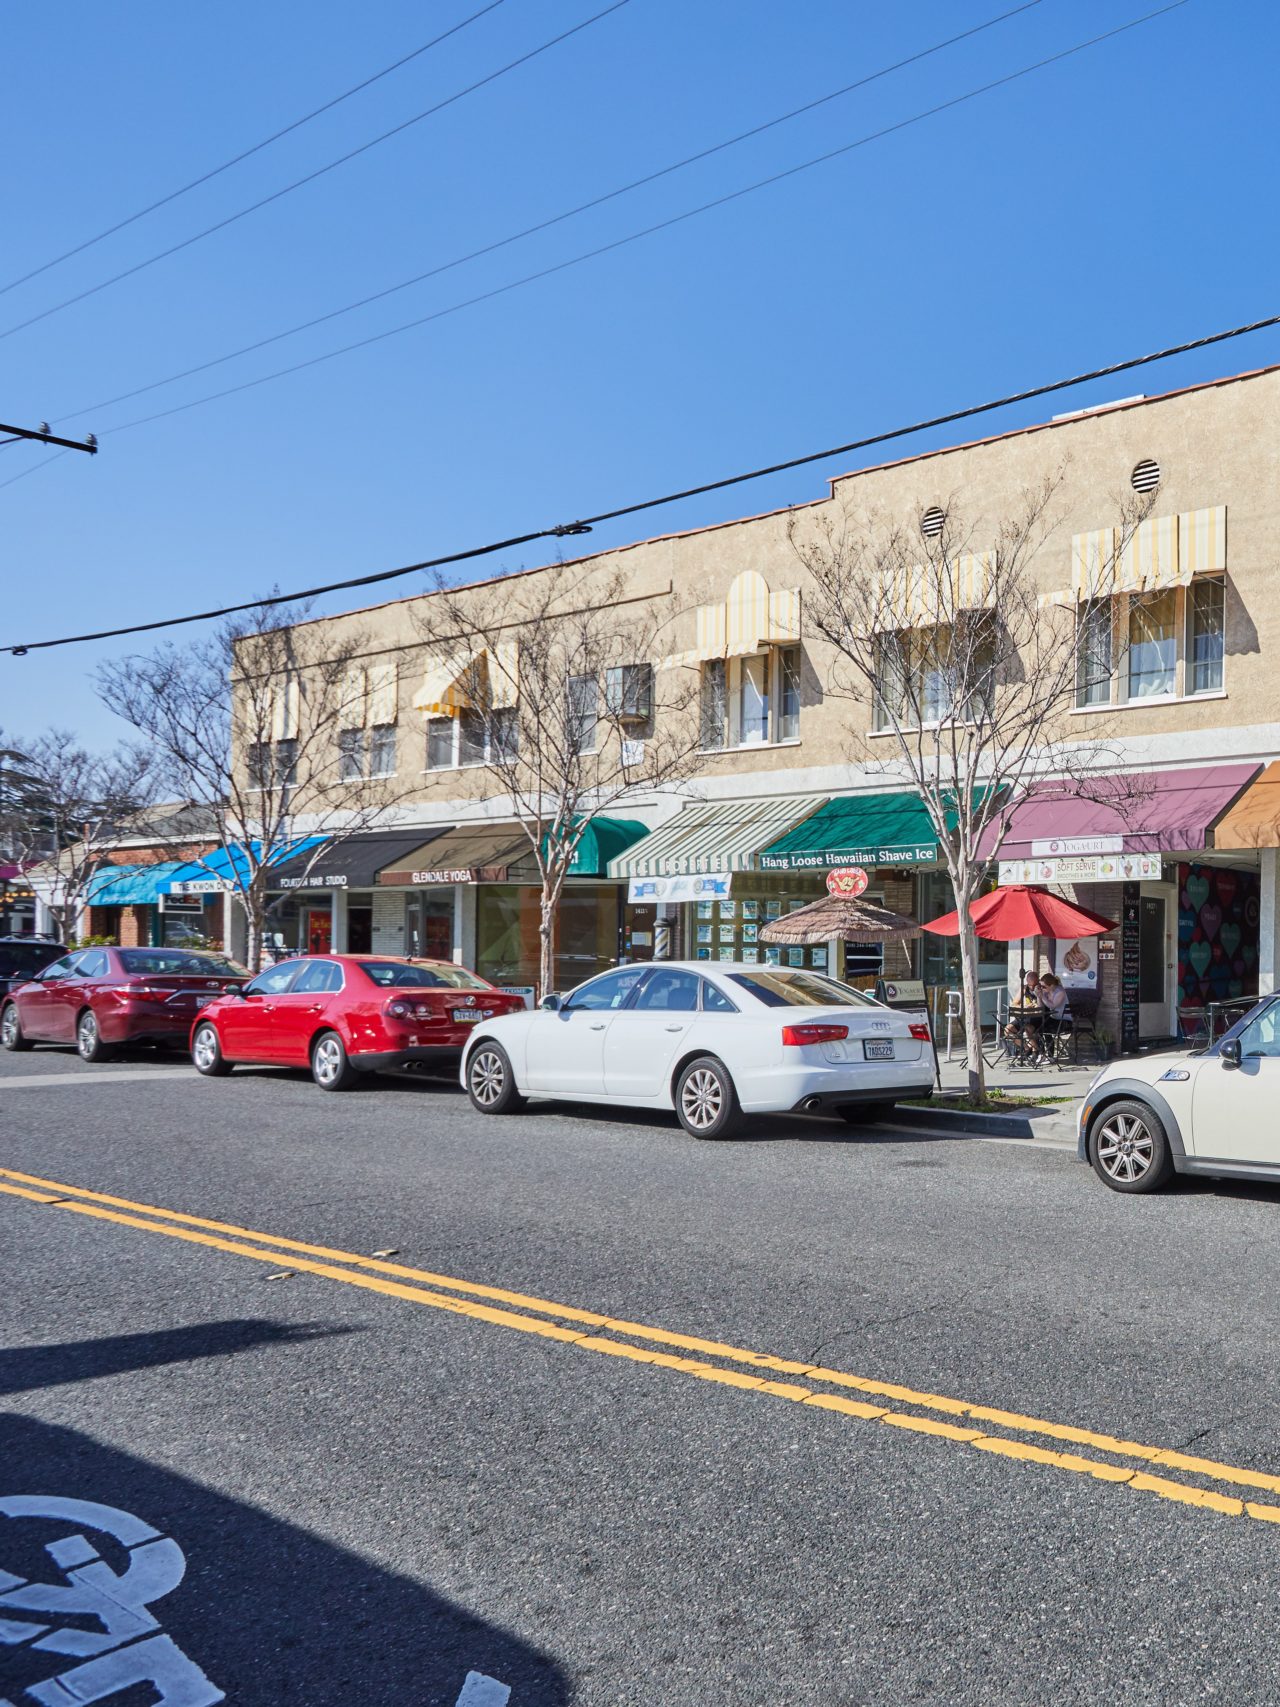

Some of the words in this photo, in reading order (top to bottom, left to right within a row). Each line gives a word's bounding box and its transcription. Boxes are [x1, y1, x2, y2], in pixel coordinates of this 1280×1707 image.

[762, 857, 789, 869] Hang
[791, 855, 823, 866] Loose
[825, 852, 876, 864] Hawaiian
[878, 850, 912, 862] Shave
[916, 849, 934, 860] Ice
[1057, 861, 1073, 872] SOFT
[1076, 861, 1096, 871] SERVE
[310, 876, 323, 887] HAIR
[325, 875, 347, 885] STUDIO
[412, 870, 449, 883] GLENDALE
[450, 869, 472, 881] YOGA
[164, 893, 202, 905] FedEx
